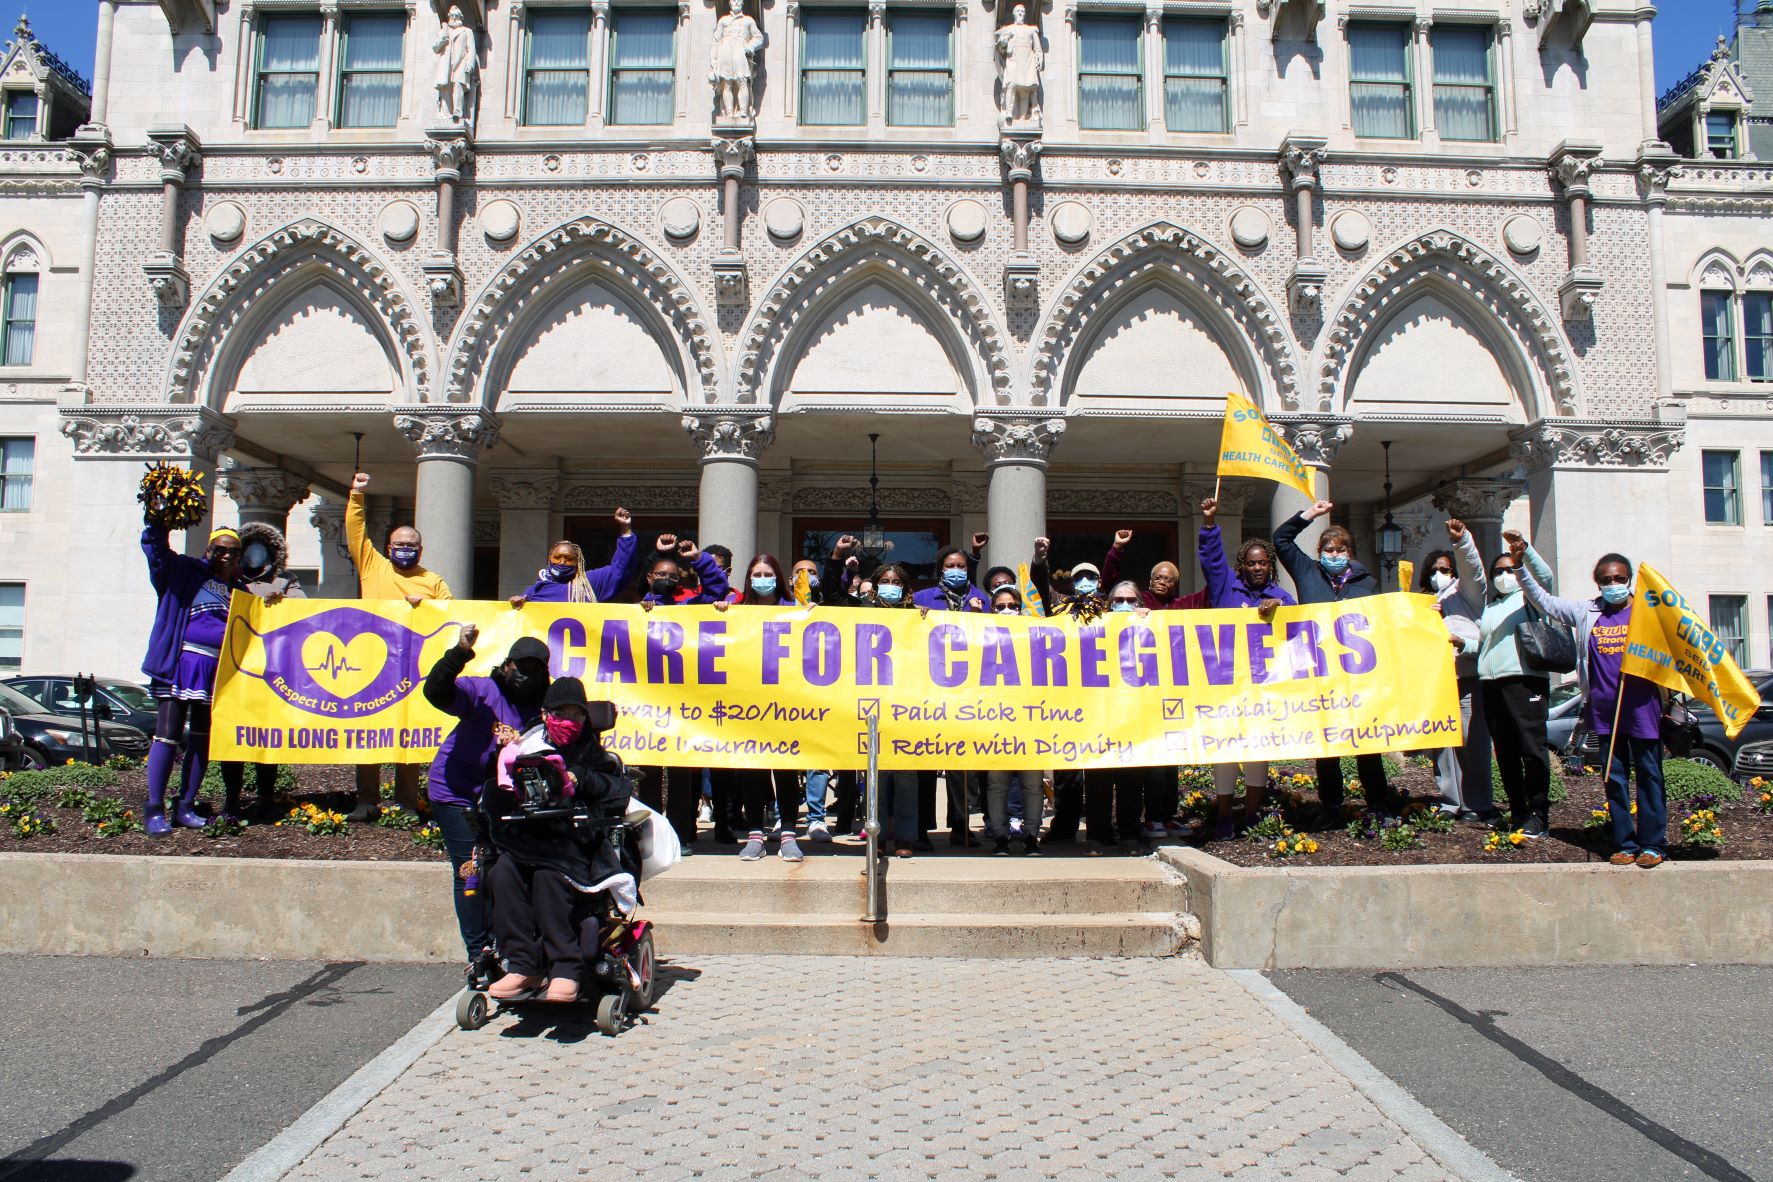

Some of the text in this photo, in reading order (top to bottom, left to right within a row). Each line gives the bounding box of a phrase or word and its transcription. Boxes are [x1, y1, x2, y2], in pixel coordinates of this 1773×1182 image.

[1222, 451, 1261, 462] HEALTH
[1264, 456, 1291, 473] CARE
[547, 613, 1377, 688] CARE FOR CAREGIVERS
[1598, 645, 1625, 655] Toget
[1626, 642, 1672, 668] HEALTH
[1673, 659, 1706, 686] CARE
[272, 676, 413, 713] Respect US Protect US
[1195, 690, 1361, 721] Racial Justice
[680, 702, 702, 721] to
[708, 700, 830, 726] $20/hour
[891, 700, 1084, 723] Paid Sick Time
[235, 725, 442, 749] FUND LONG TERM CARE
[677, 735, 800, 755] Insurance
[1201, 715, 1458, 750] Protective Equipment
[891, 732, 1134, 763] Retire with Dignity
